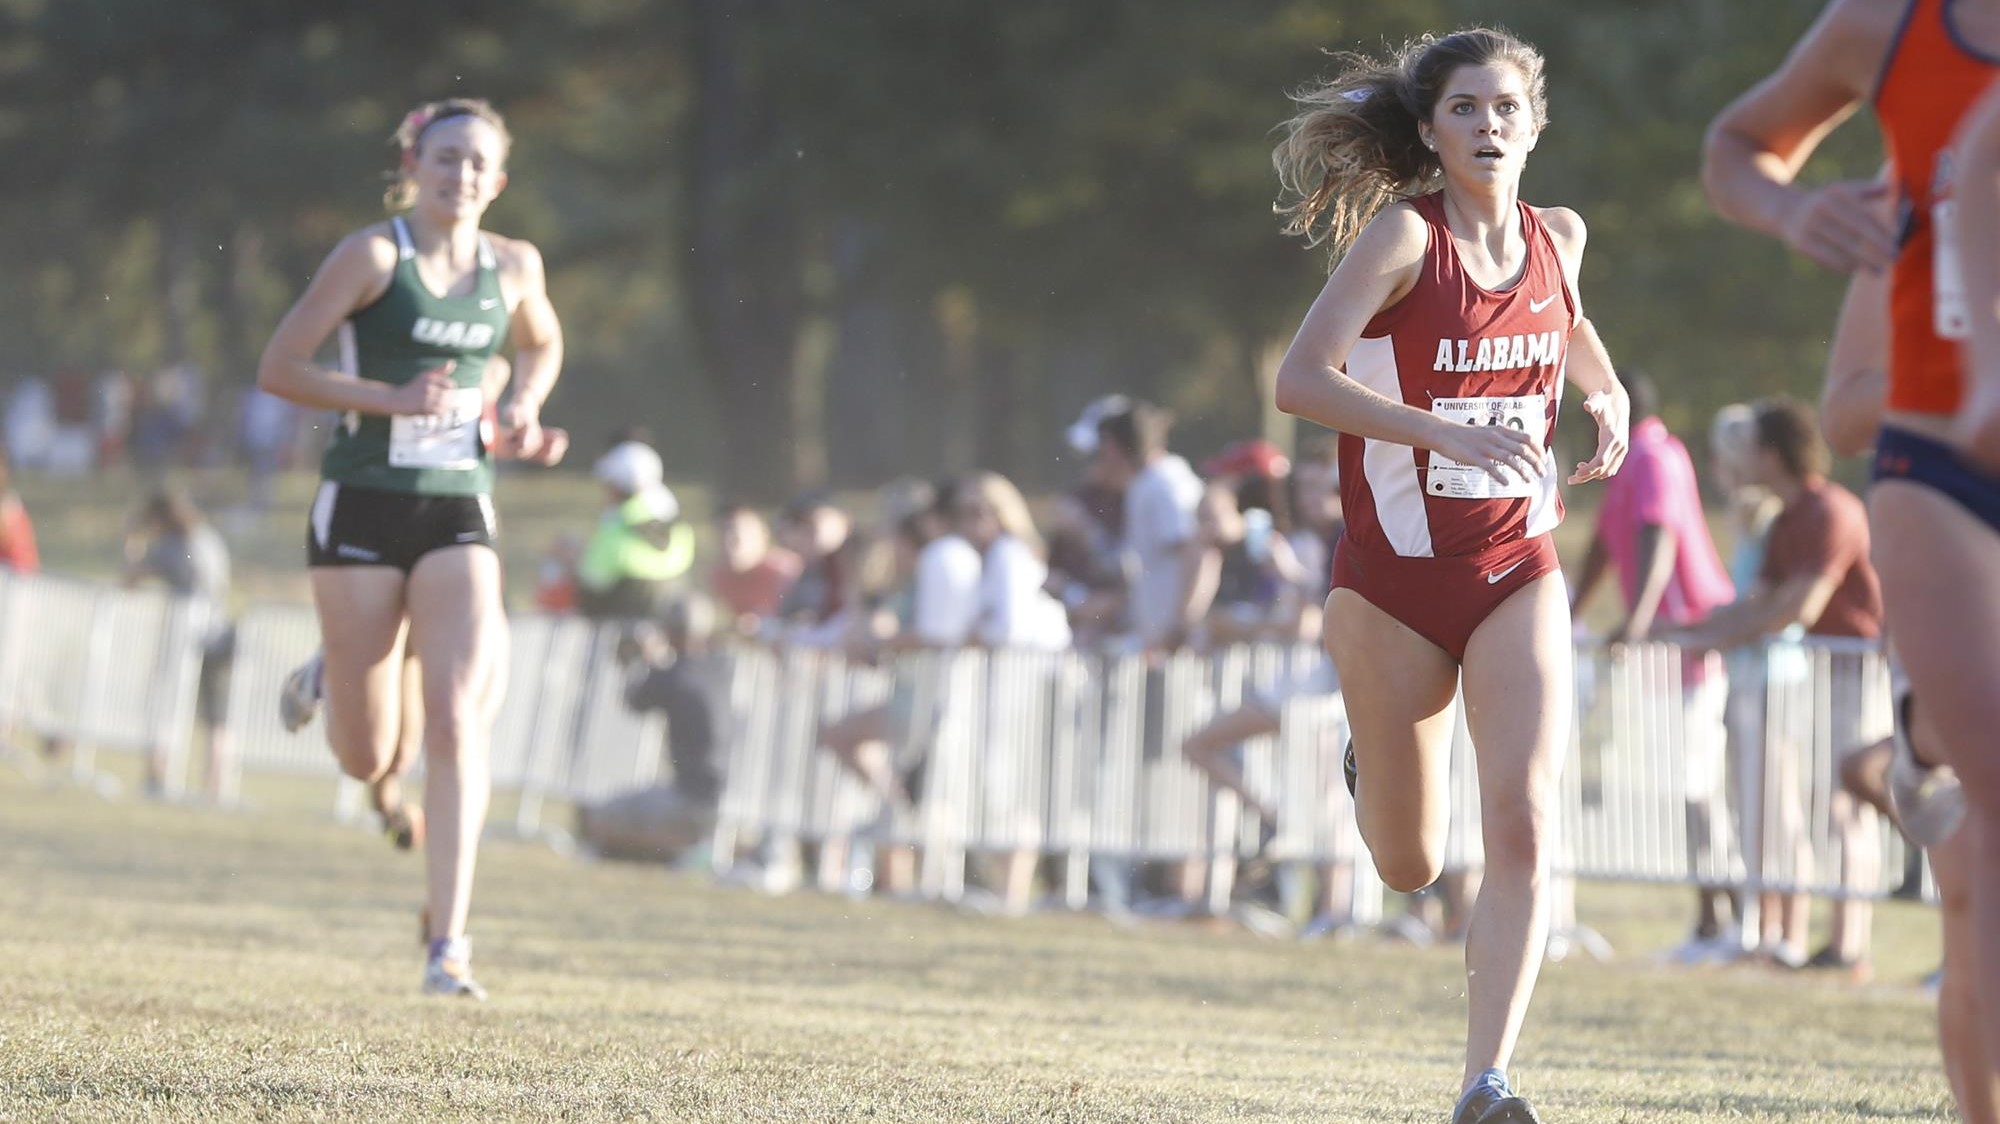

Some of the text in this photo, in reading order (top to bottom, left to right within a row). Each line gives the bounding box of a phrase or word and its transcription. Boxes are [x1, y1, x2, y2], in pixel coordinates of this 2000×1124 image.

[412, 317, 493, 348] UAB
[1433, 331, 1560, 372] ALABAMA
[1491, 402, 1502, 410] OF
